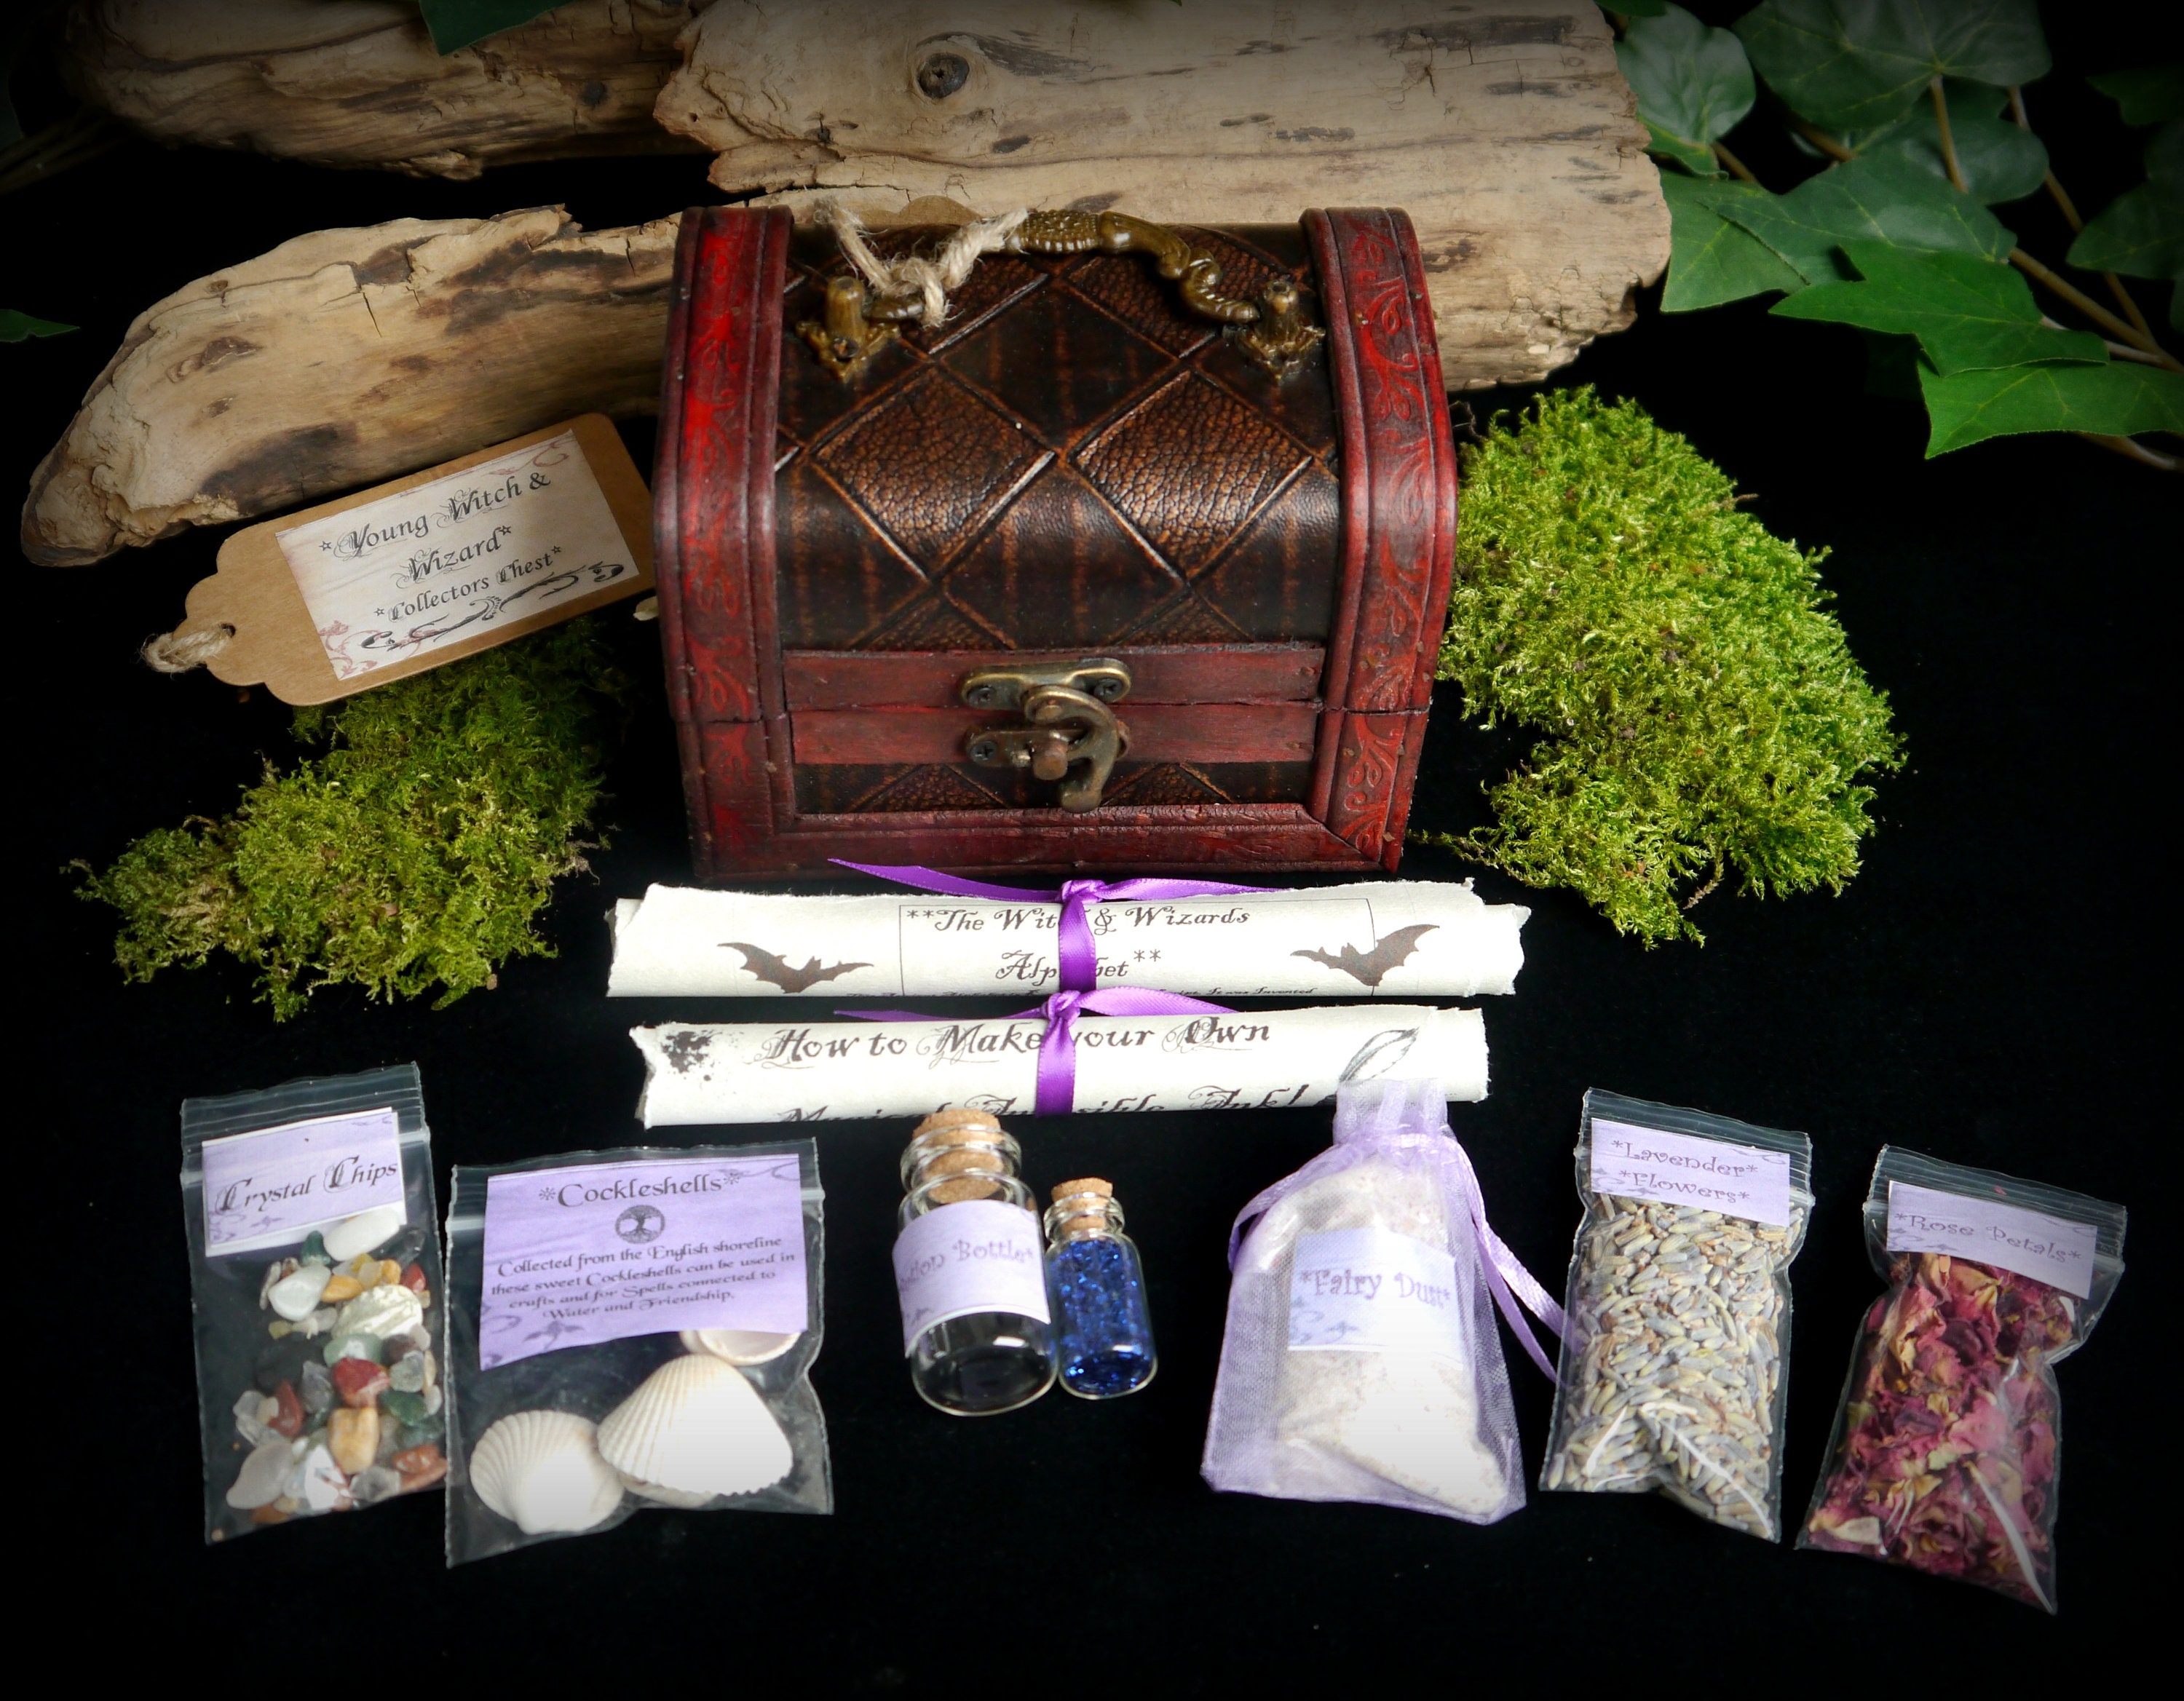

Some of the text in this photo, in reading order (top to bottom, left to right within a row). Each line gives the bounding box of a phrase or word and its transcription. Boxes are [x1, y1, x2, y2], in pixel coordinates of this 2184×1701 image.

[430, 473, 523, 529] Witch
[529, 472, 551, 491] &
[994, 907, 1090, 931] Wit
[1093, 907, 1117, 936] &
[1125, 905, 1250, 928] Wizards
[995, 948, 1162, 987] Alpbet
[744, 1028, 859, 1069] How
[868, 1032, 907, 1056] to
[917, 1020, 1041, 1069] Make
[1163, 1016, 1270, 1053] Own
[215, 1155, 398, 1216] Crystal Chips
[491, 1252, 795, 1295] these sweet Cockleshells can be used in
[497, 1237, 783, 1277] Collected from the English shoreline
[509, 1271, 776, 1311] crafts and for Spells connected to
[542, 1306, 601, 1319] Water
[604, 1300, 633, 1312] and
